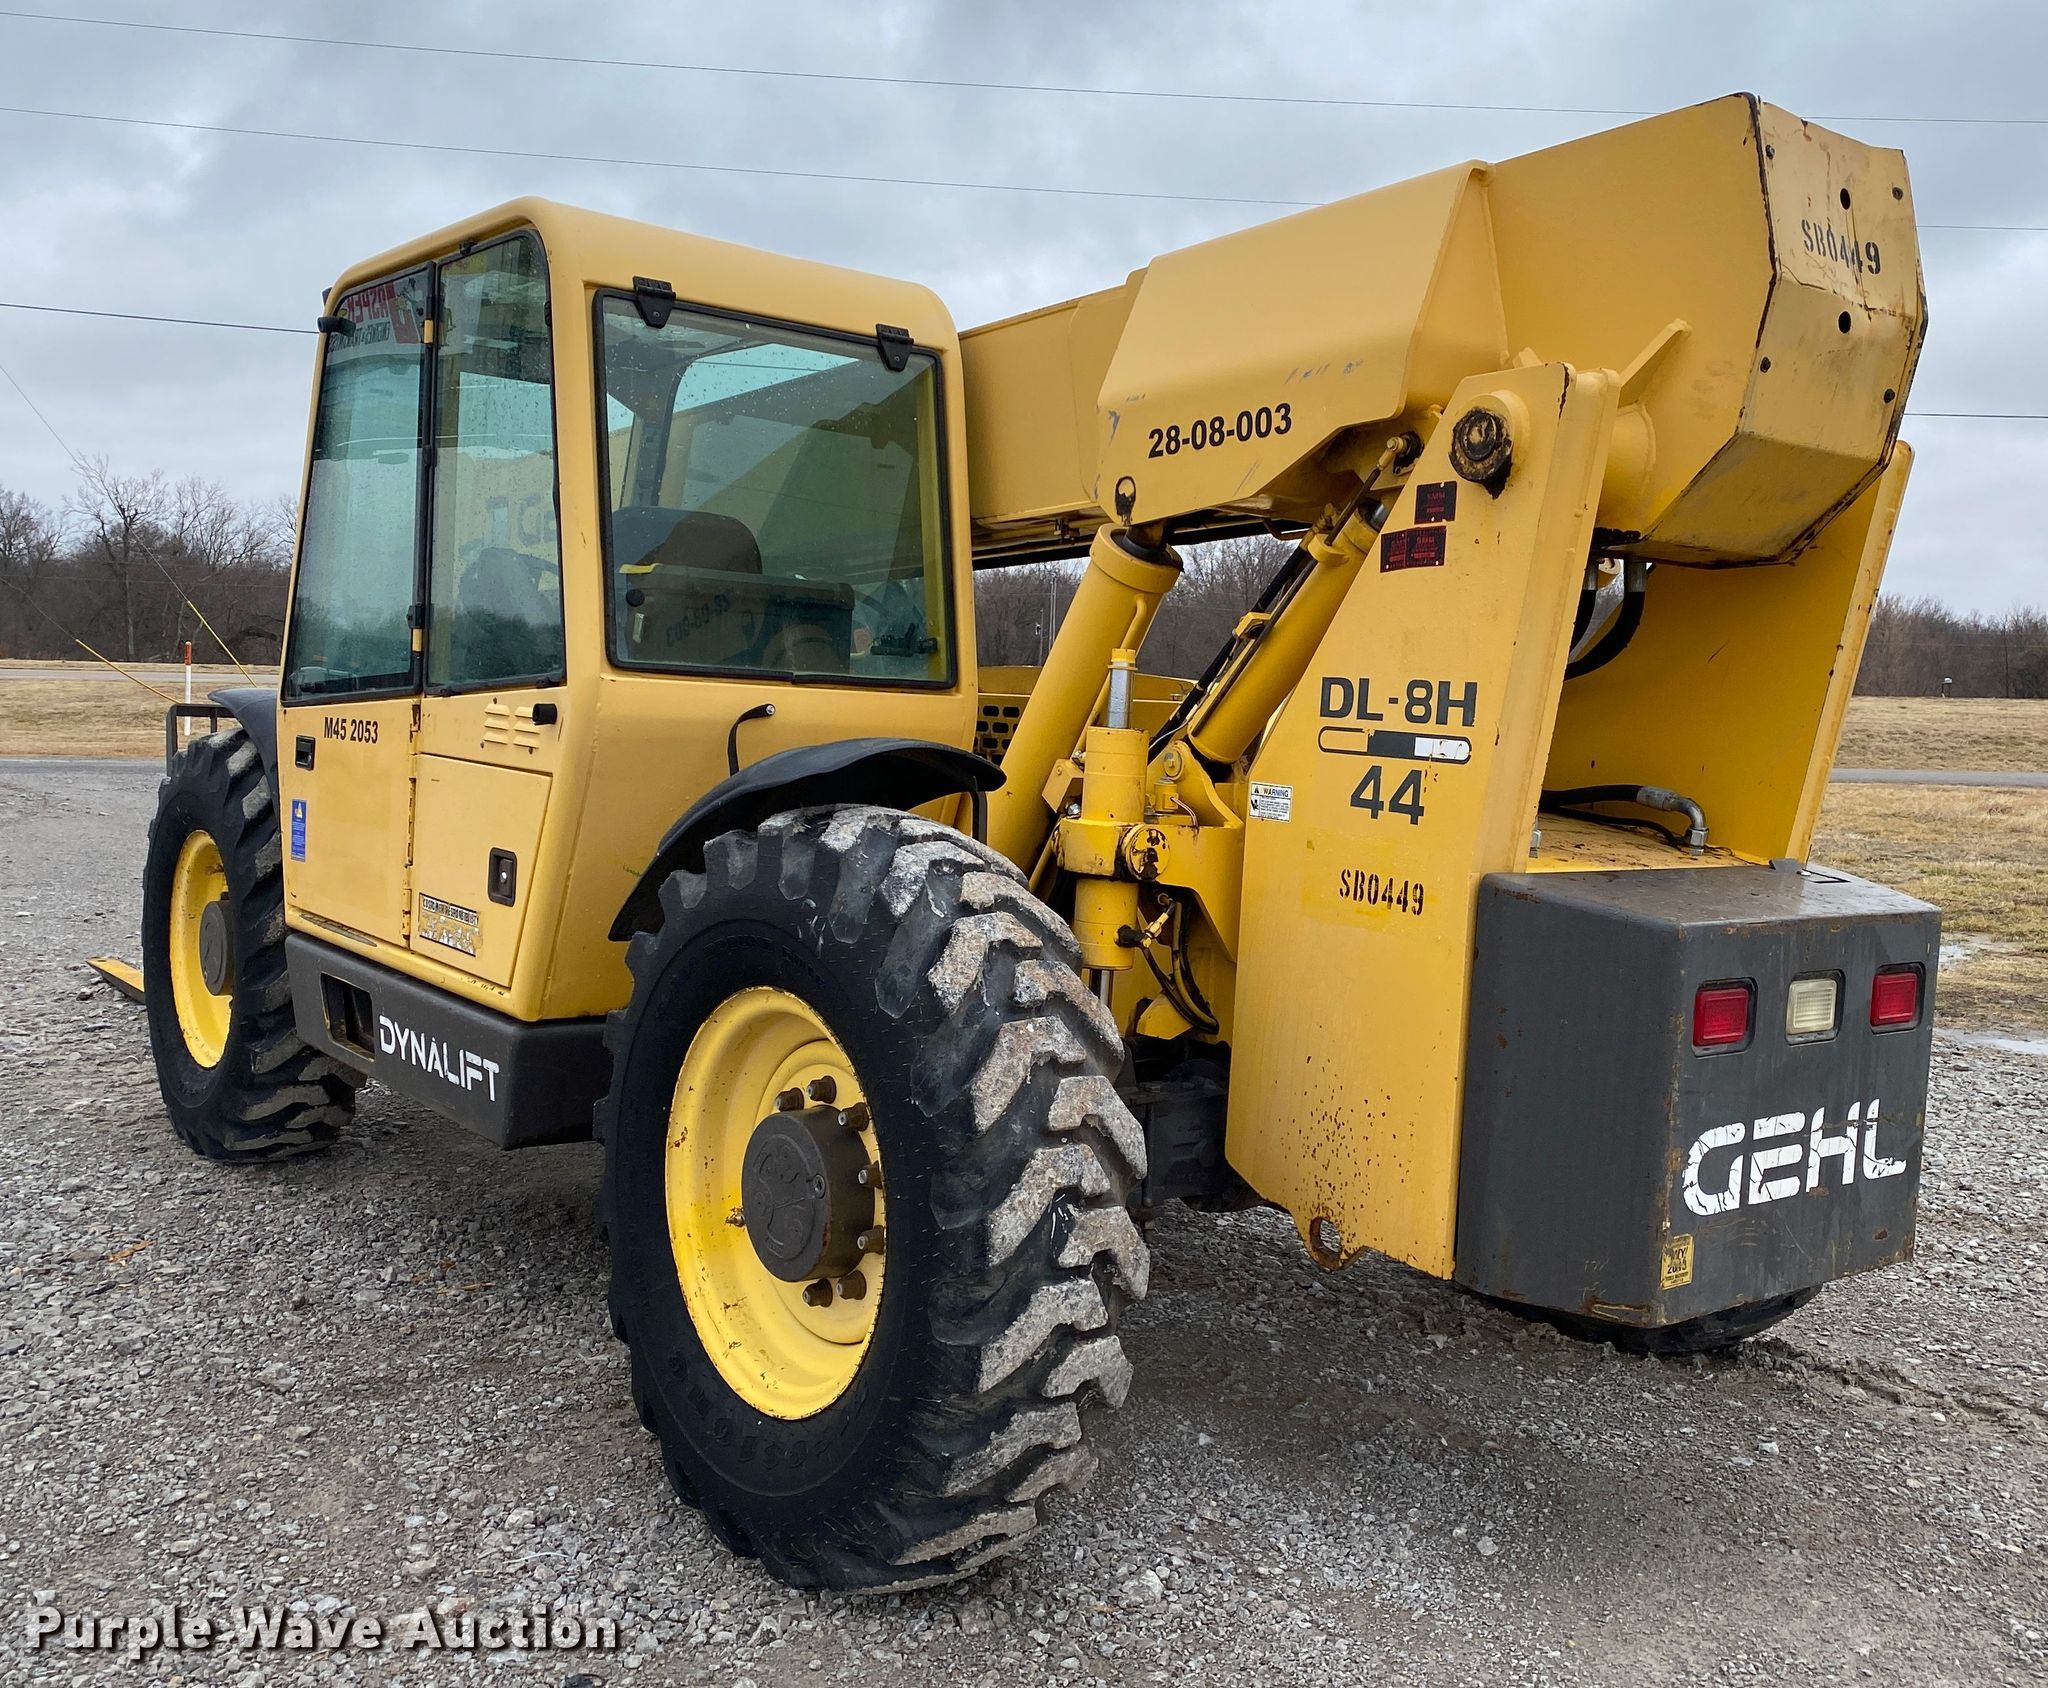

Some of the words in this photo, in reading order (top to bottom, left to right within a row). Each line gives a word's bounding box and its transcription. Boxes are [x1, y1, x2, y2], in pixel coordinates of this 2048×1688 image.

[1801, 218, 1881, 275] SB0449
[1148, 402, 1292, 459] 28-08-003
[323, 716, 347, 741] M45
[350, 719, 379, 744] 2053
[1319, 676, 1478, 728] DL-8H
[1263, 787, 1289, 798] WARNING
[1350, 764, 1425, 826] 44
[1339, 868, 1424, 916] SB0449
[379, 1015, 500, 1102] DYNALIFT
[1681, 1098, 1907, 1216] GEHL
